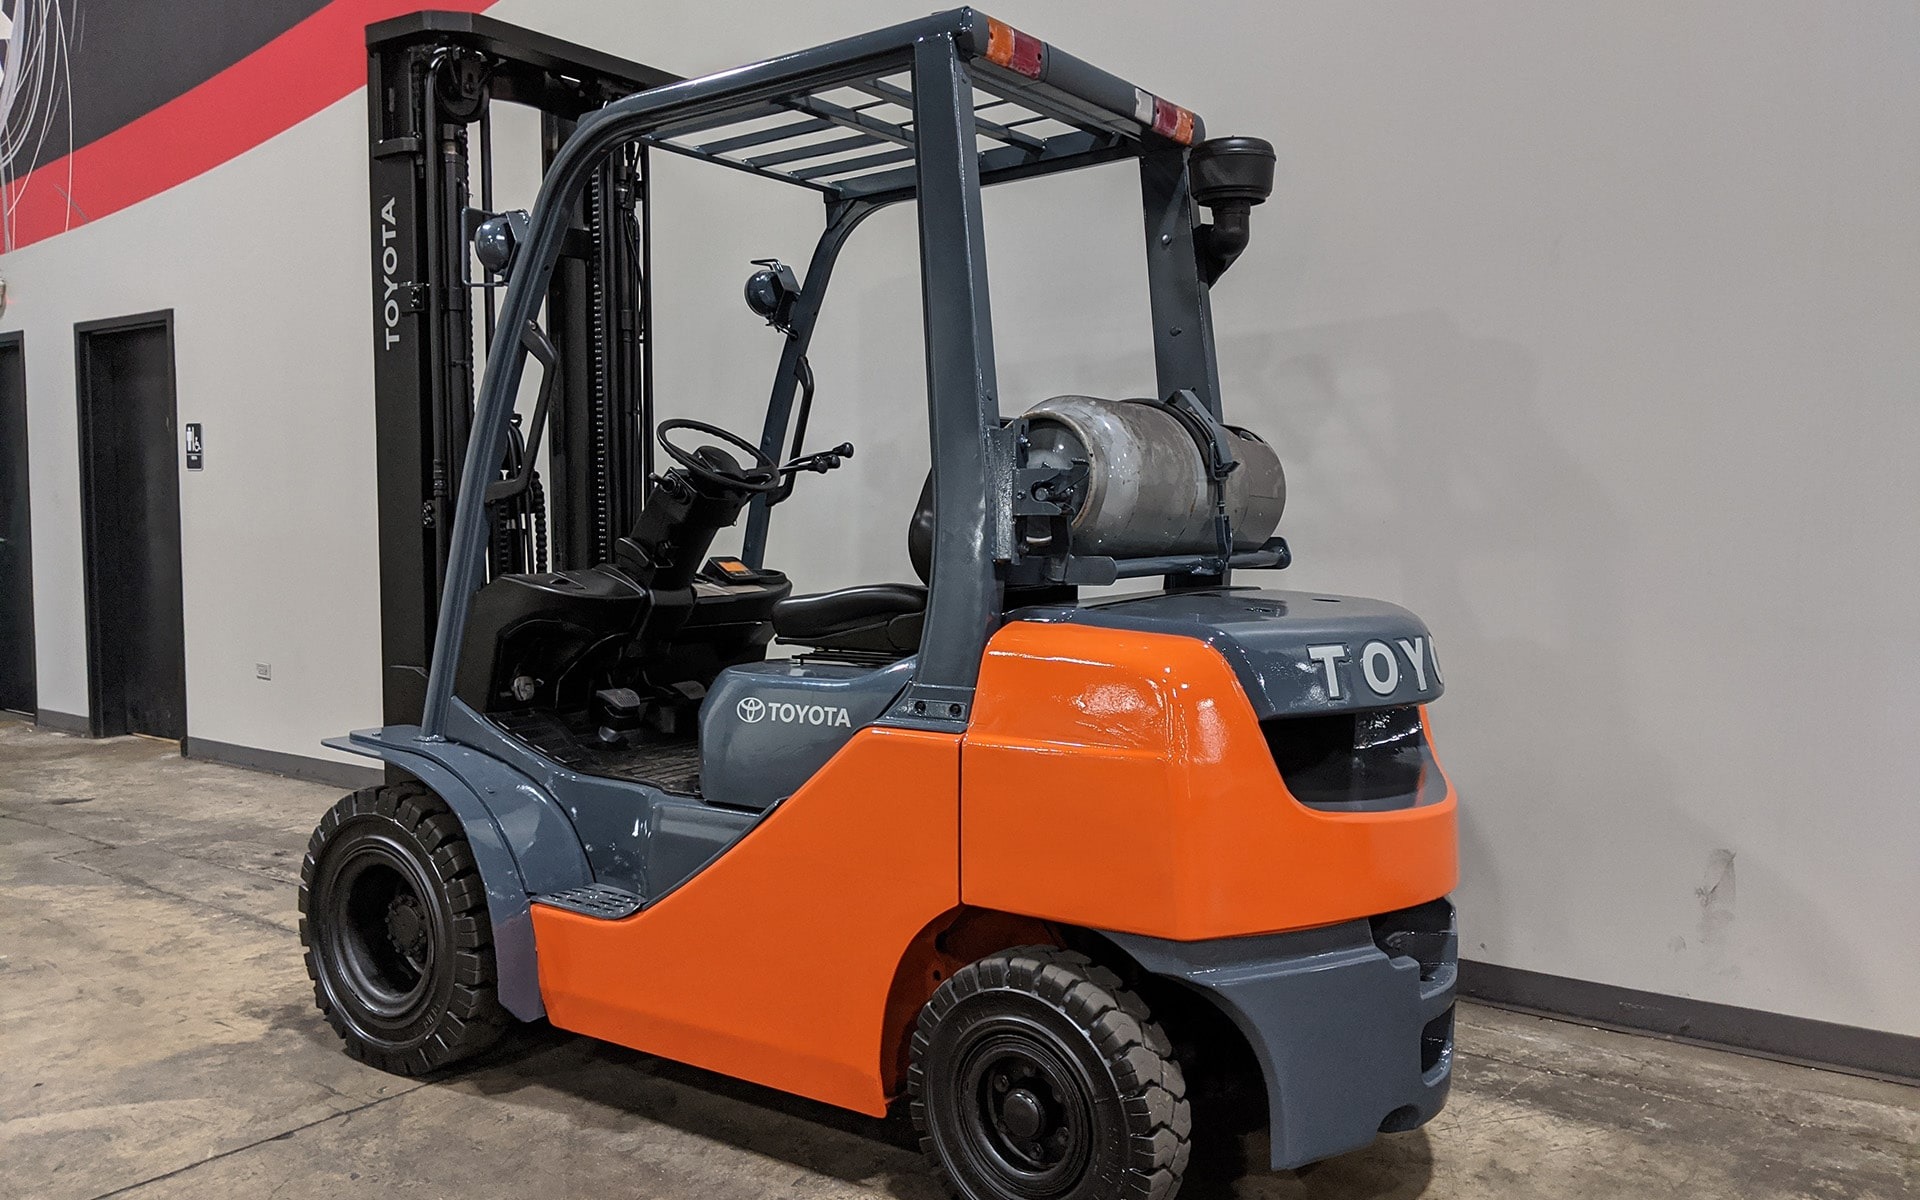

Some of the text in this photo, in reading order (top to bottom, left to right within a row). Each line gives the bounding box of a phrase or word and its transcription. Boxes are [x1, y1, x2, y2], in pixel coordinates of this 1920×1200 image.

[381, 197, 400, 350] TOYOTA
[1307, 635, 1444, 698] TOY
[768, 702, 851, 727] TOYOTA
